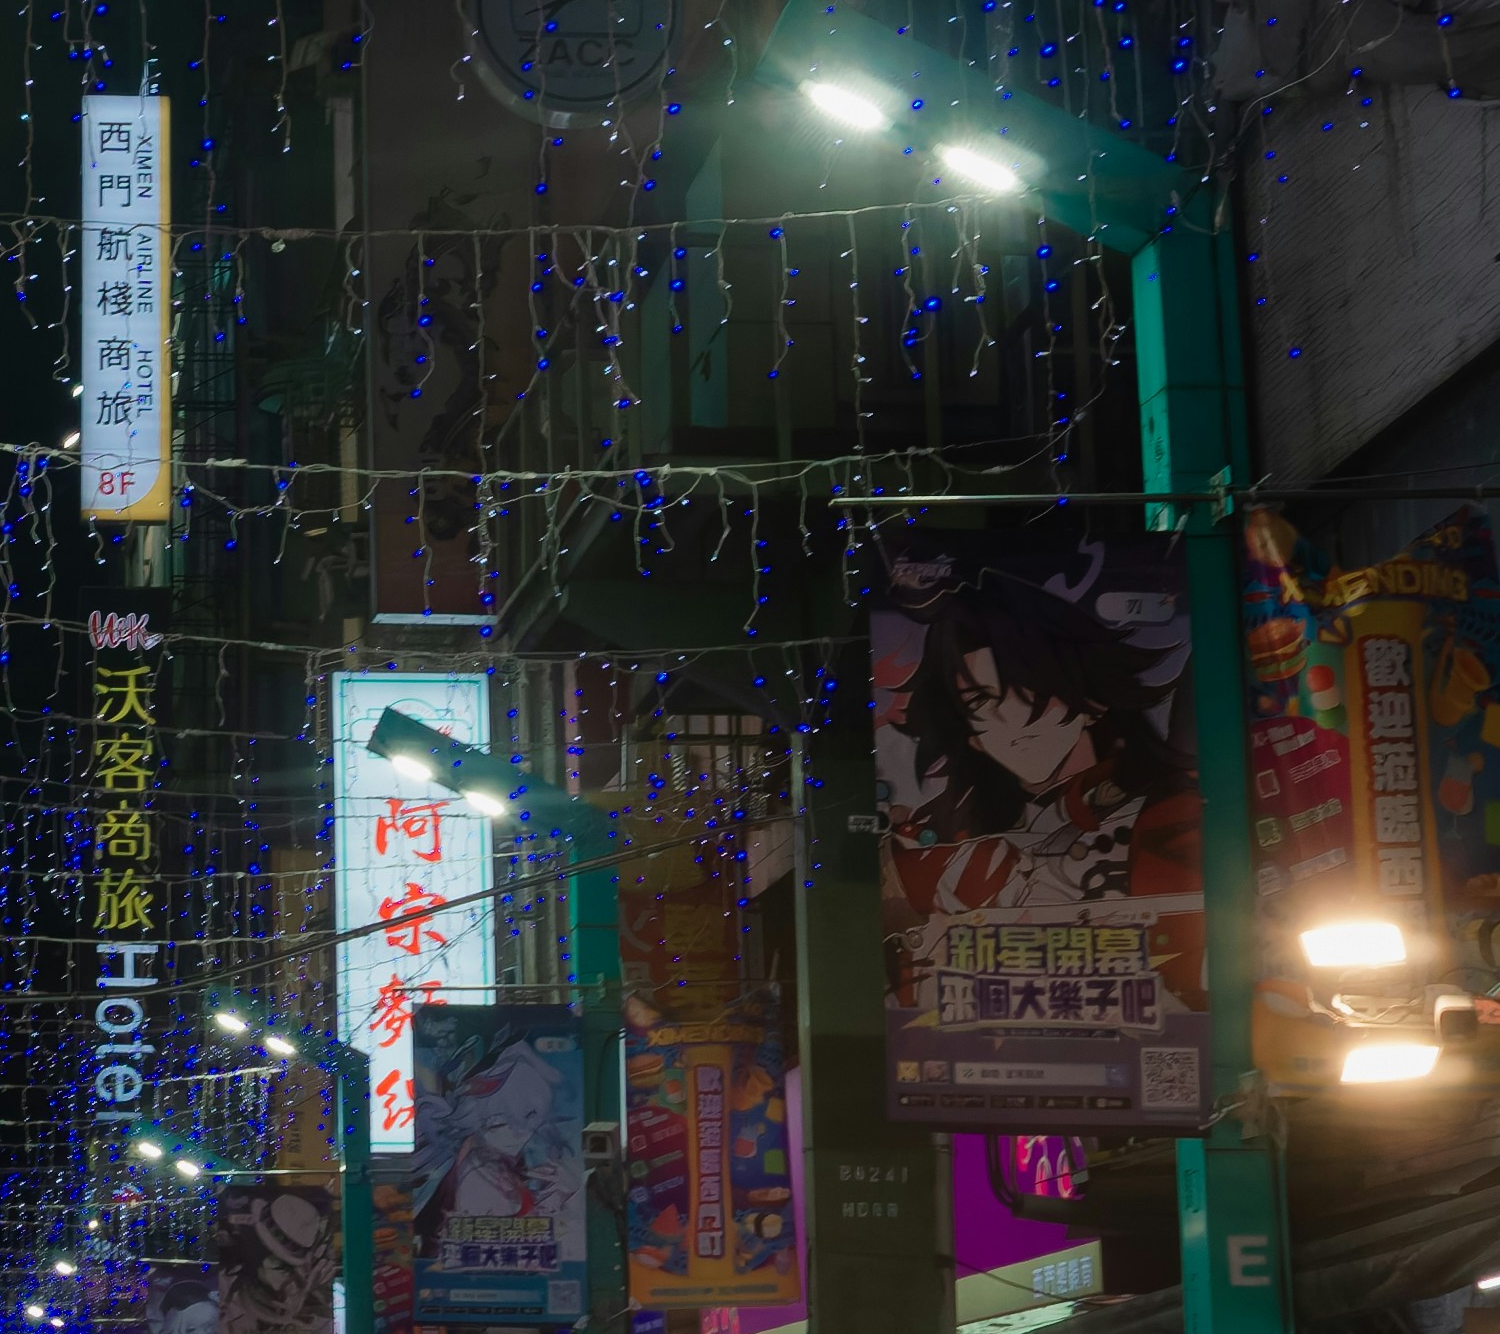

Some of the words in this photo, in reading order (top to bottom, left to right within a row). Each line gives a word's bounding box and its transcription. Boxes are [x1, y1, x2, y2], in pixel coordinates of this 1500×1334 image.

[517, 37, 636, 68] ZACC
[136, 136, 153, 199] XIMEN
[98, 122, 133, 426] 西門航棧商旅
[136, 233, 153, 315] AIRLINE
[136, 349, 153, 420] HOTEL
[99, 473, 136, 498] 8F
[94, 665, 155, 930] 沃客商旅
[947, 924, 1145, 974] 新星開幕
[938, 973, 1160, 1024] 來個大樂子吧
[94, 942, 158, 1121] Hotel
[1227, 1235, 1271, 1286] E
